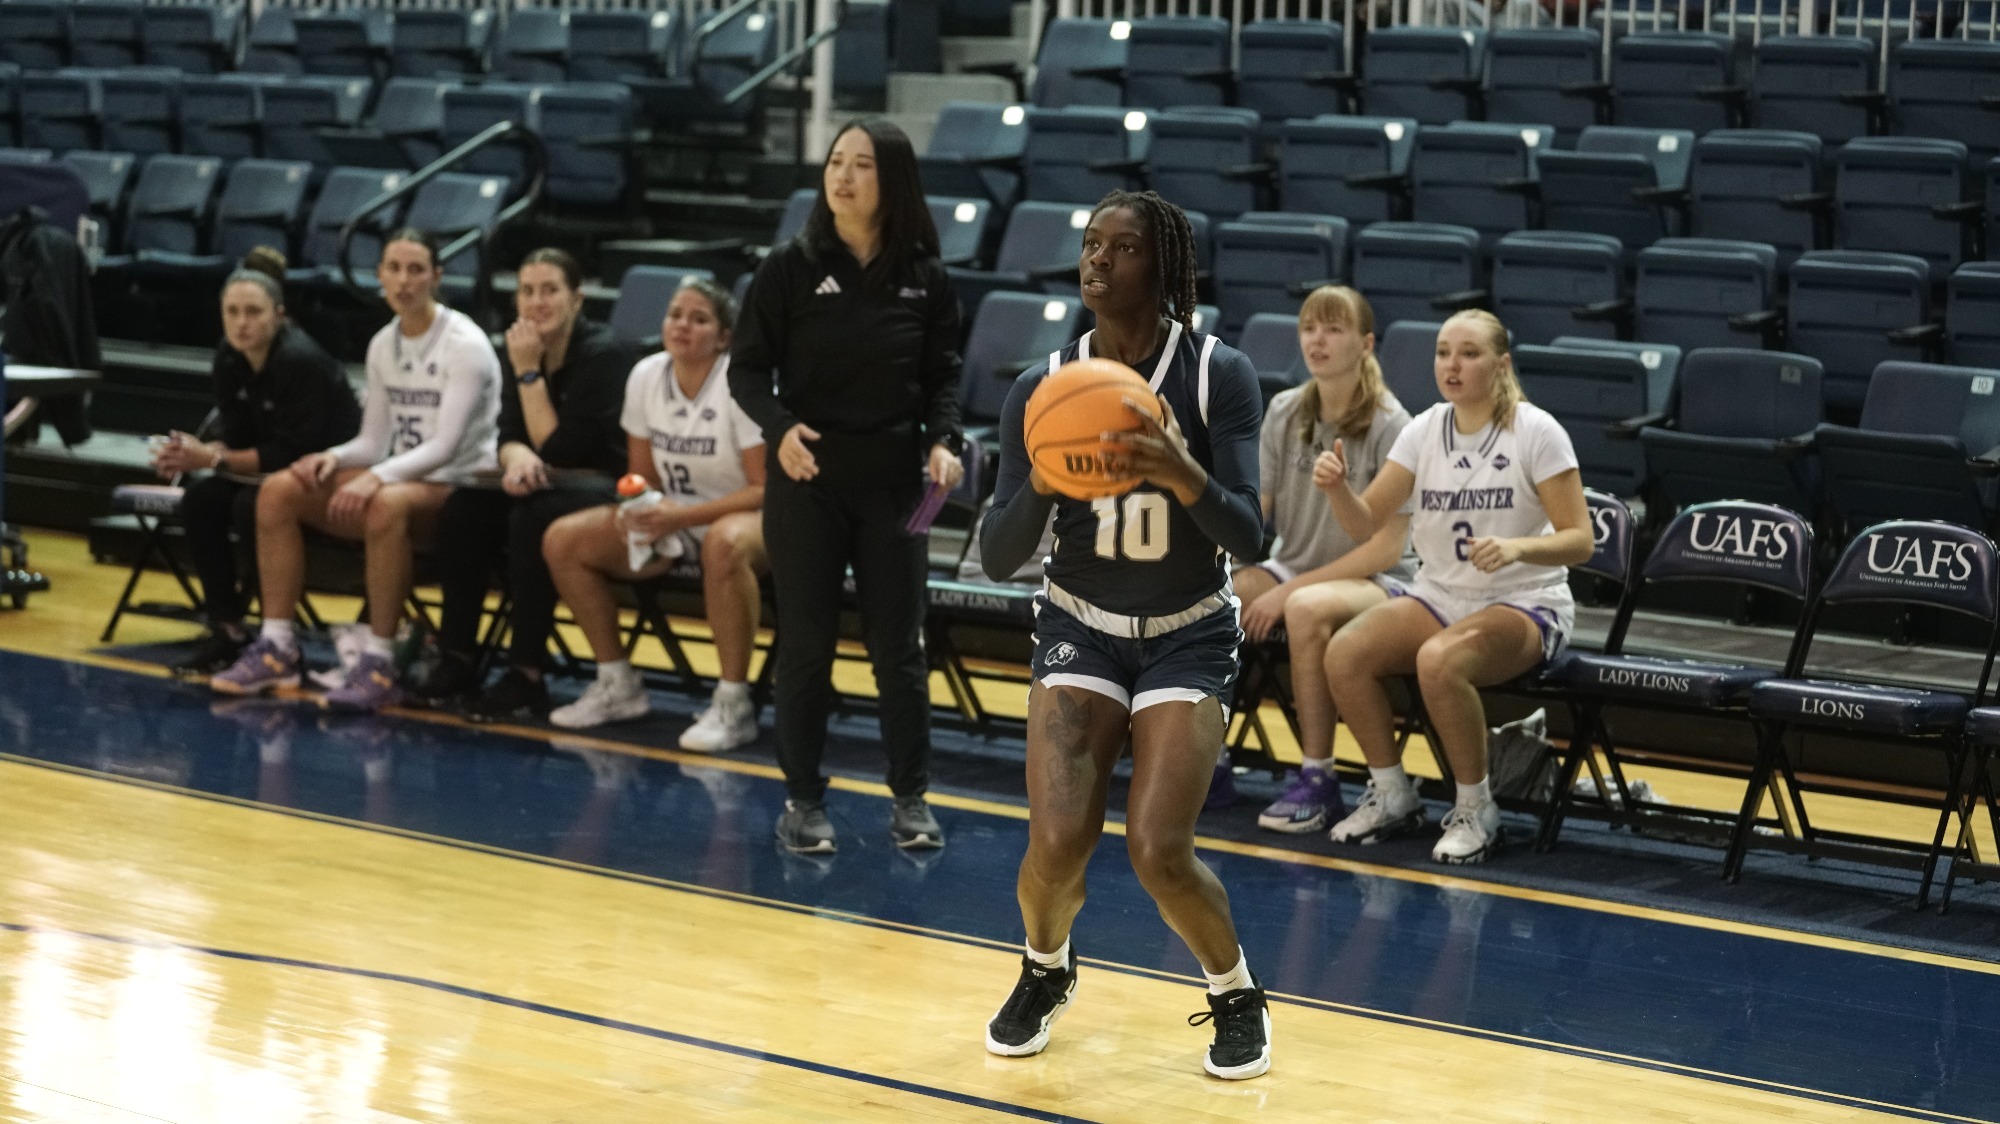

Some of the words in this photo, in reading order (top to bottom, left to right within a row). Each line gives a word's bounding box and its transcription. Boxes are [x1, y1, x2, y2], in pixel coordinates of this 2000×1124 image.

[663, 461, 697, 496] 12
[1090, 491, 1170, 562] 10
[1452, 520, 1474, 563] 2
[1690, 511, 1795, 561] UAFS
[1867, 533, 1978, 582] UAFS
[930, 589, 965, 607] LADY
[967, 593, 1010, 613] LIONS
[1599, 667, 1640, 687] LADY
[1642, 672, 1690, 692] LIONS
[1801, 696, 1865, 720] LIONS
